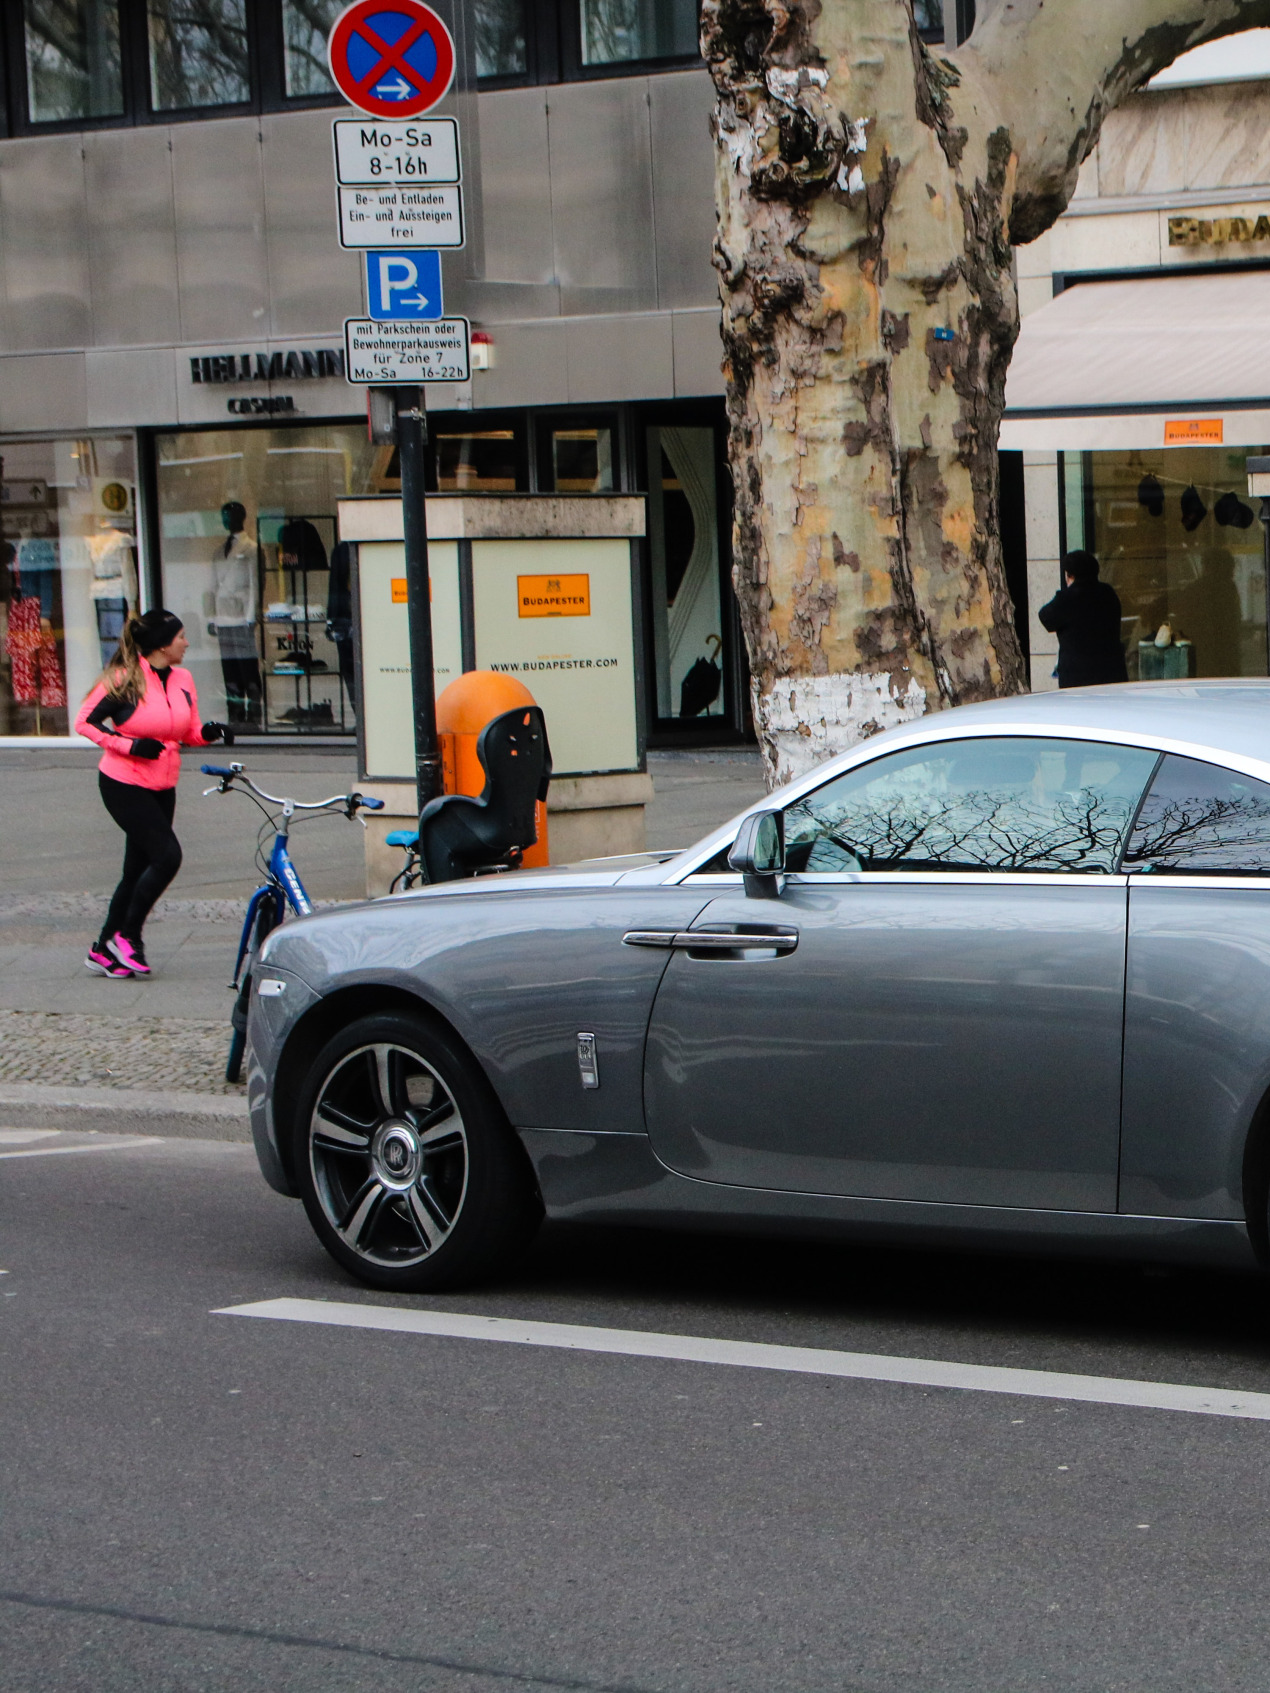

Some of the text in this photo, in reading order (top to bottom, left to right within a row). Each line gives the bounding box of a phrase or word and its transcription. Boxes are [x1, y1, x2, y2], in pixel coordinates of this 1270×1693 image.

[361, 128, 433, 148] Mo-Sa
[370, 156, 428, 175] 8-16h
[355, 193, 444, 205] Be- und Entladen
[349, 209, 453, 224] Ein- und Aussteigen
[391, 227, 414, 238] frei
[379, 256, 418, 311] P
[357, 323, 456, 335] mit Parkschein oder
[353, 338, 462, 351] Bewohnerparkausweis
[373, 353, 443, 364] für Zone 7
[355, 367, 463, 379] Mo-Sa 16-22h
[522, 596, 585, 606] BUDAPESTER
[490, 658, 618, 672] WWW.BUDAPESTER.COM
